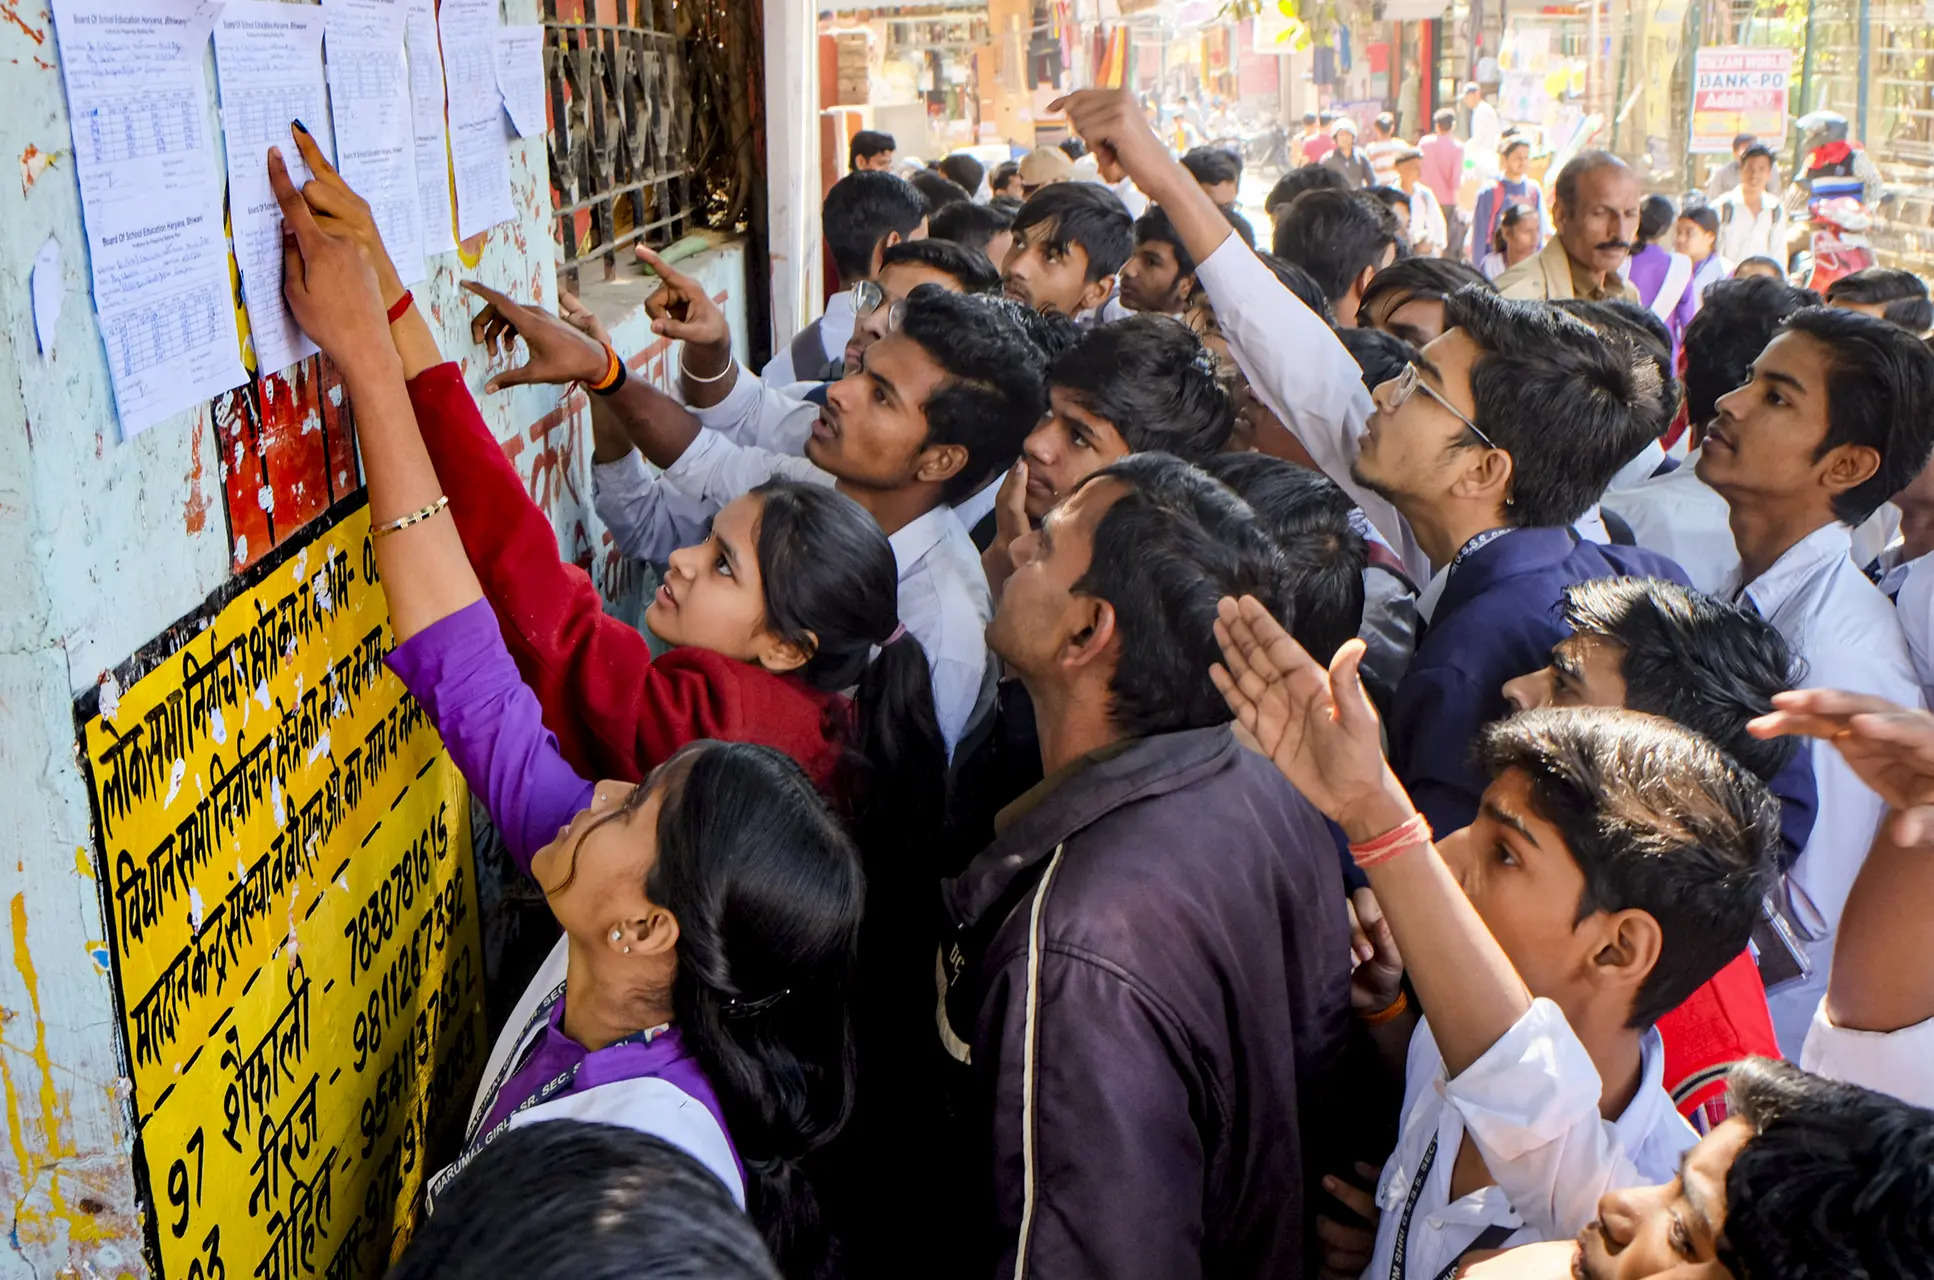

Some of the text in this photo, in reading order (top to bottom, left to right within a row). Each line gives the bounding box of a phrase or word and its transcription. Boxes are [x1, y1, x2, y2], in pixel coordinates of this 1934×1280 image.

[1699, 71, 1784, 89] BANK-PO
[99, 719, 147, 840] लोक
[144, 688, 185, 801] सभा
[182, 629, 250, 754] निर्वाचन
[116, 833, 178, 960] विधान
[175, 796, 213, 897] सभा
[209, 728, 274, 851] निर्वाचन
[129, 945, 193, 1069] मतदान
[364, 718, 387, 788] नाम
[167, 1125, 205, 1239] 97
[344, 801, 448, 987] 7838781615
[248, 866, 467, 1219] नीरज 9811267392
[433, 1142, 484, 1197] MARUMAL
